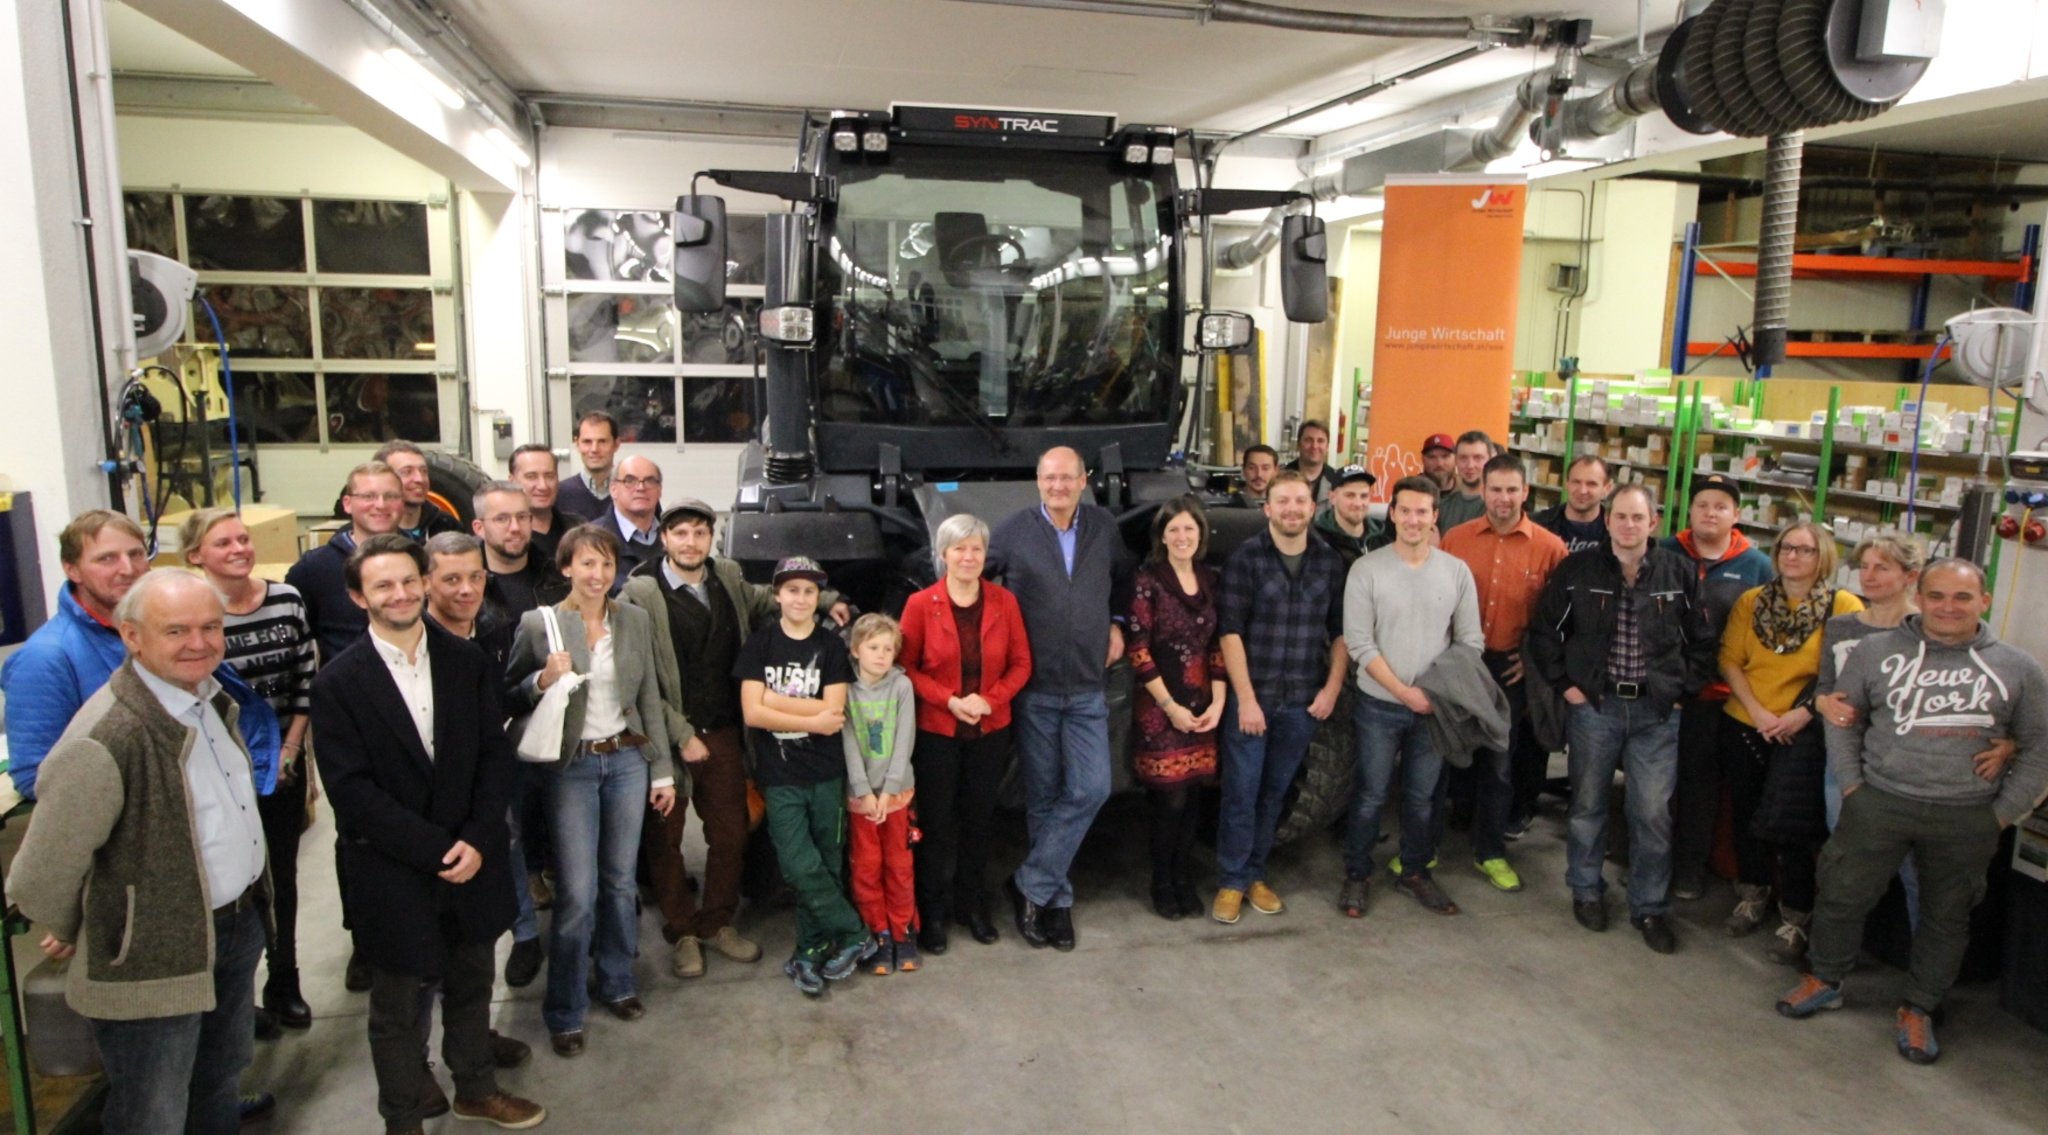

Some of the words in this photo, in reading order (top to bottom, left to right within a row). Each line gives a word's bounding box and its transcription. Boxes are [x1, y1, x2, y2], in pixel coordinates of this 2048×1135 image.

[953, 115, 1059, 133] SYNTRAC
[1385, 326, 1428, 343] Junge
[1431, 326, 1505, 341] Wirtschaft
[1880, 653, 1974, 688] New
[1886, 674, 1993, 736] York
